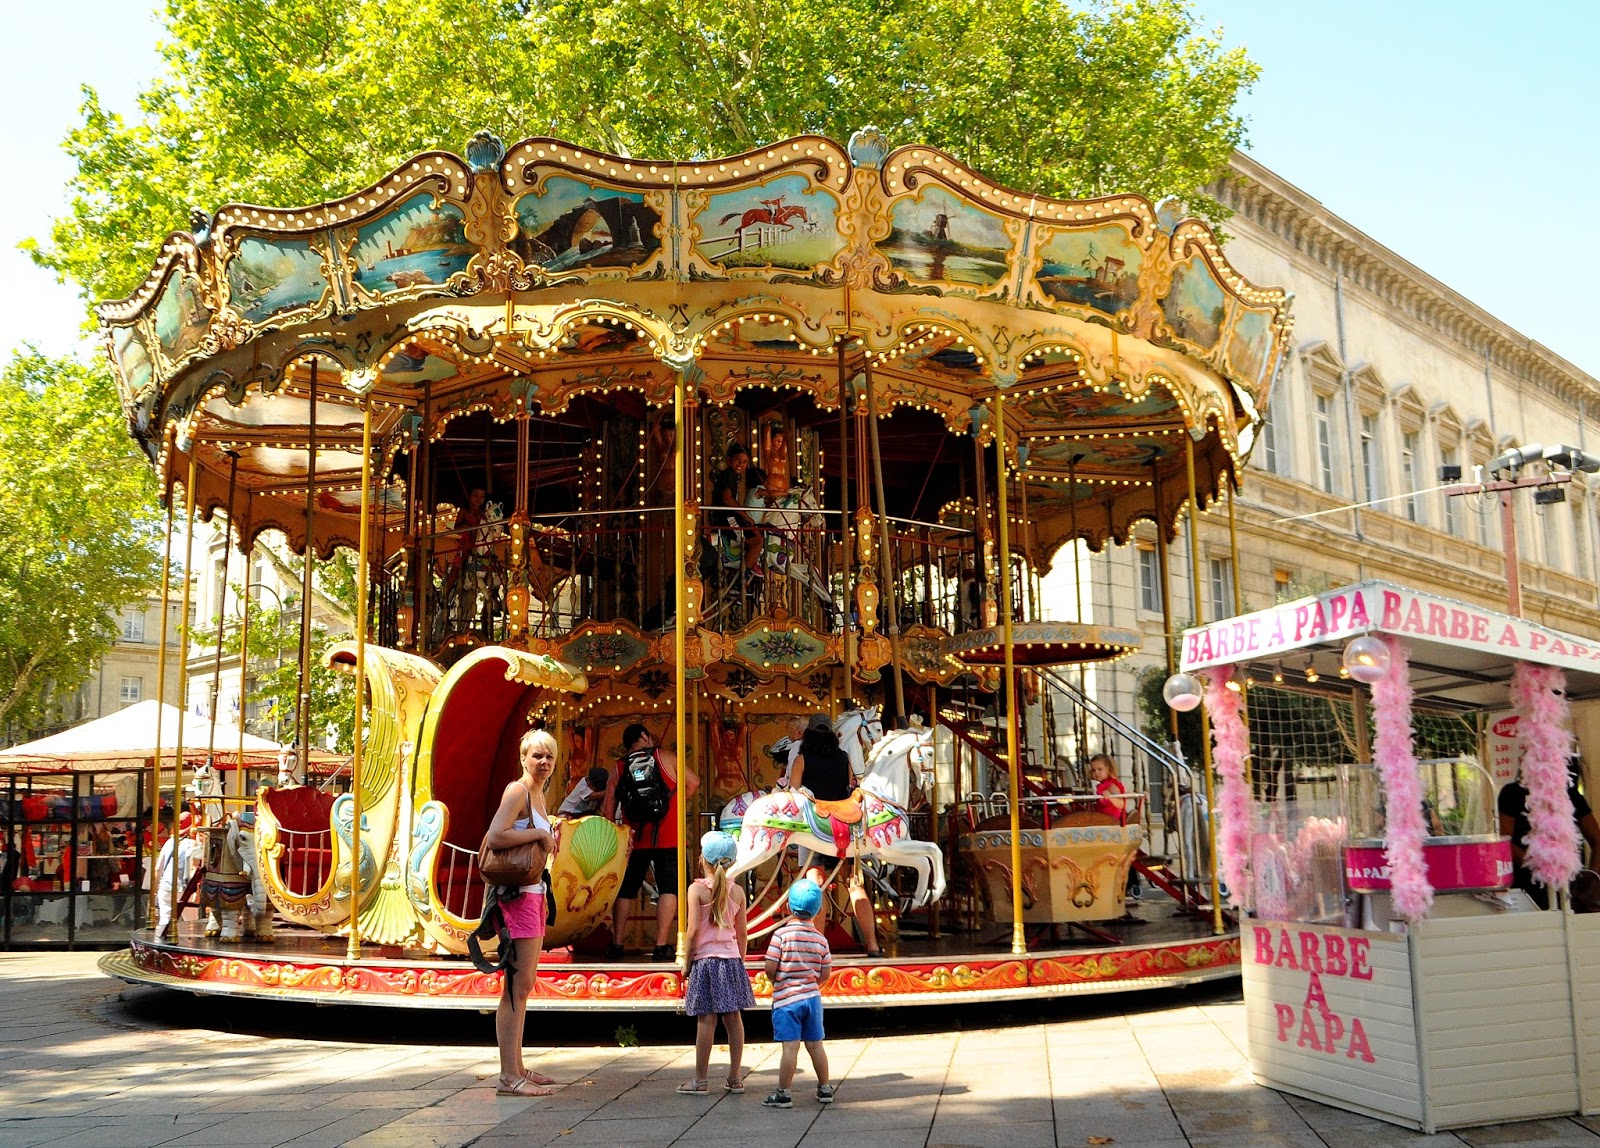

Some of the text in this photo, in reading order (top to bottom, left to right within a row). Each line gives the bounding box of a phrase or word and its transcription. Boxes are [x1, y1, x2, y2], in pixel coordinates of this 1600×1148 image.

[1187, 590, 1371, 665] BARBE A PAPA
[1380, 590, 1490, 643] BARBE
[1496, 624, 1520, 648] A
[1253, 926, 1373, 981] BARBE
[1303, 970, 1331, 1013] A
[1274, 1003, 1376, 1064] PAPA
